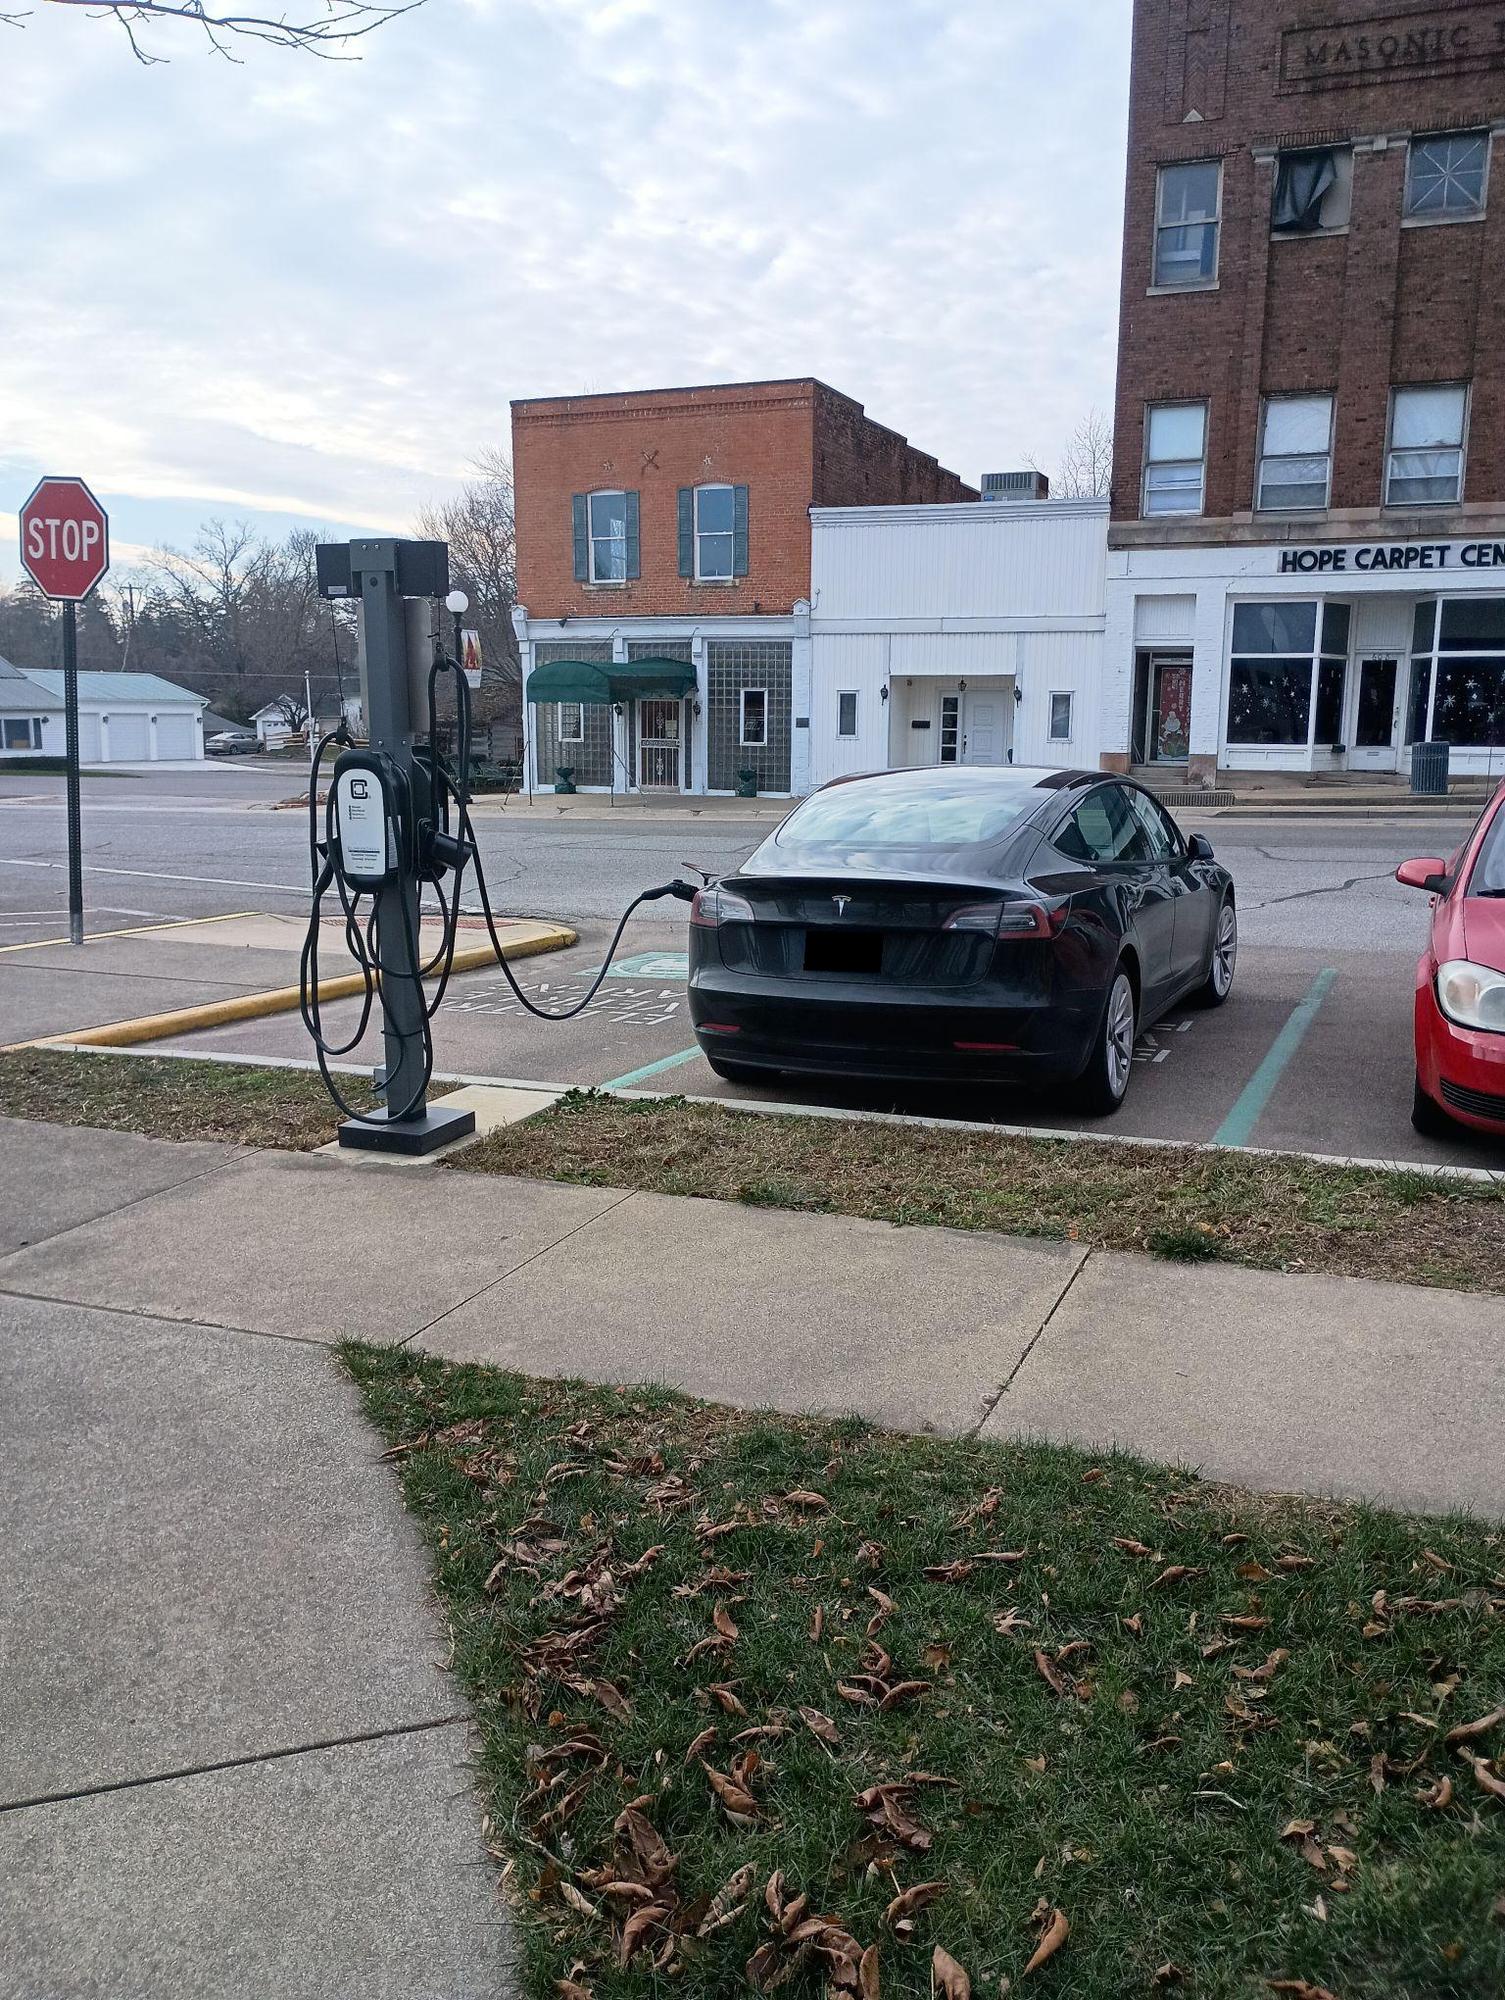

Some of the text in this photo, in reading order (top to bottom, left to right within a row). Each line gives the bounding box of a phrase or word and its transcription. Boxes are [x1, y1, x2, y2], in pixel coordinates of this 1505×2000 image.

[1305, 26, 1470, 65] MASONIC
[28, 517, 100, 561] STOP
[1281, 543, 1505, 573] HOPE CARPET CEN
[488, 983, 688, 999] ARKING
[425, 1000, 677, 1025] ELECTRI
